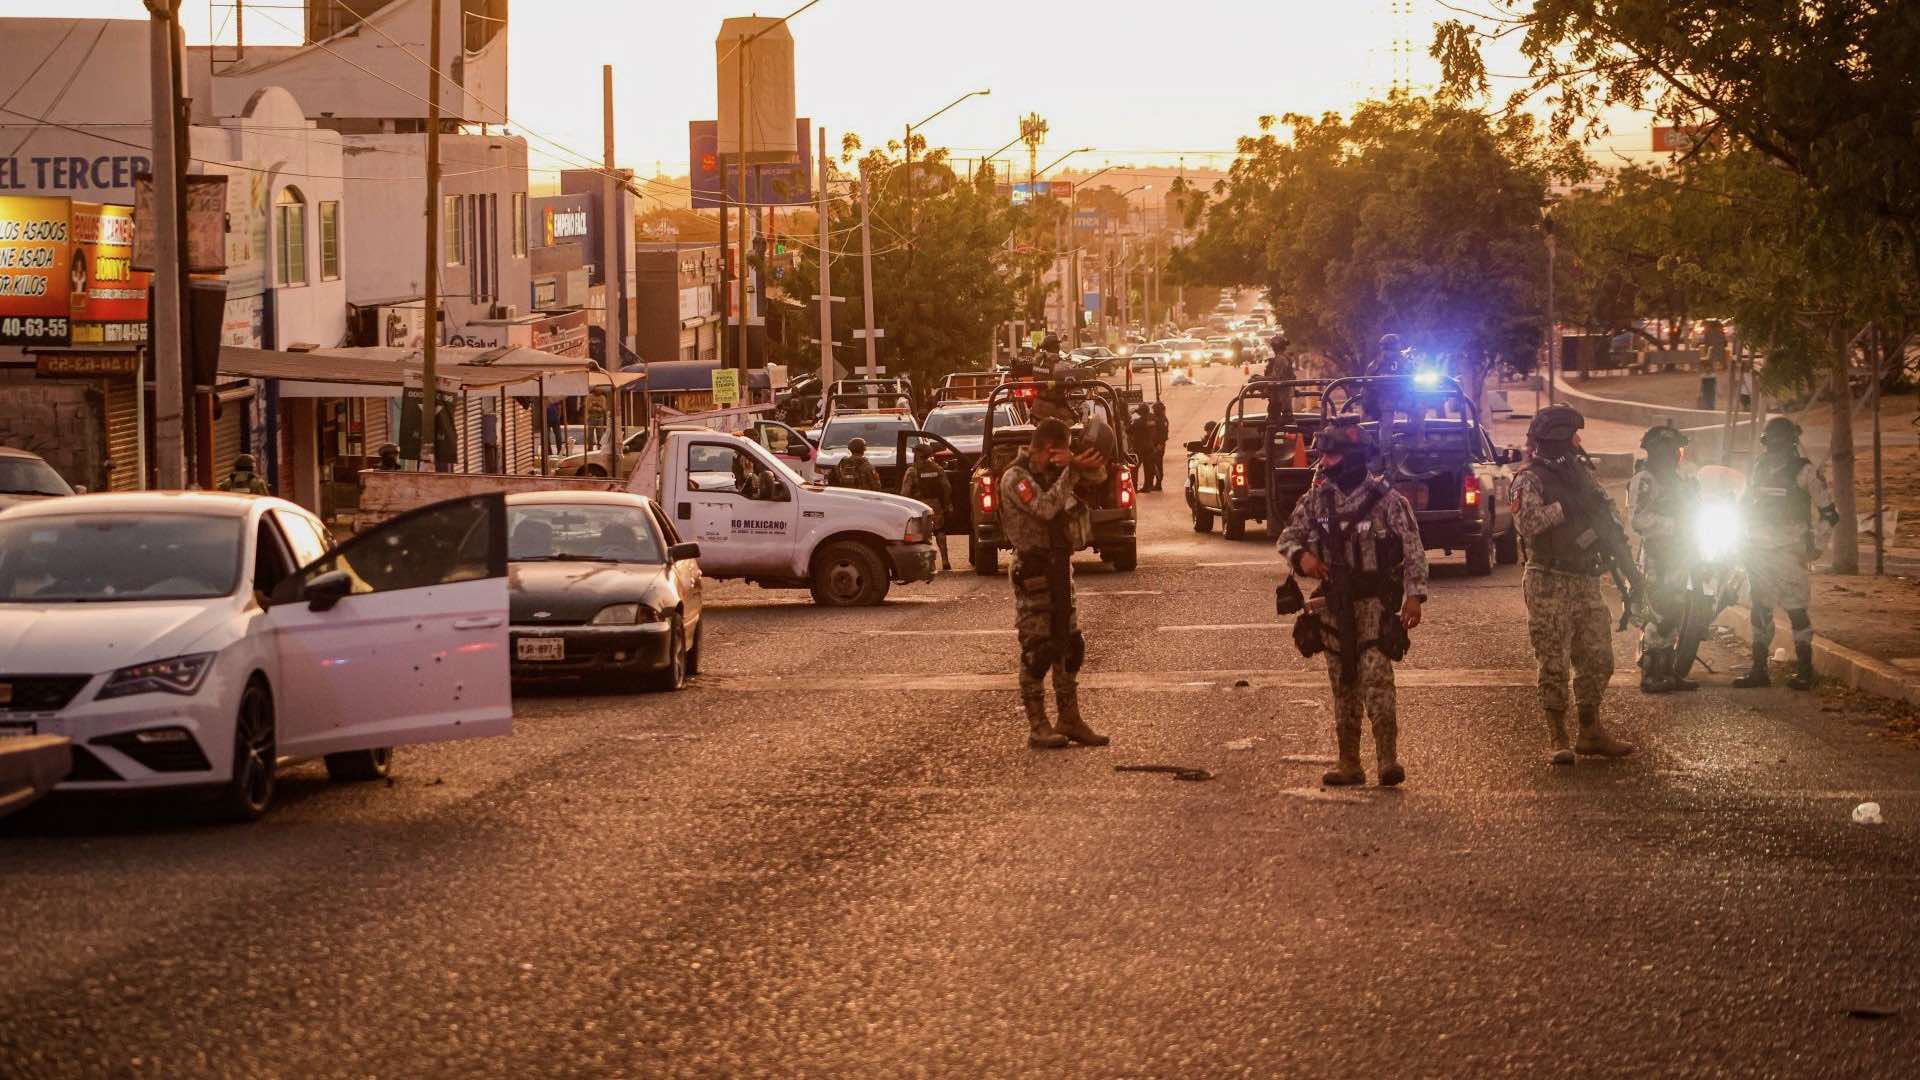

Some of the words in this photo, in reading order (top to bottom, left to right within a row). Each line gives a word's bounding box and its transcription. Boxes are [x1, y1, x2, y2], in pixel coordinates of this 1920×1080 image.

[0, 157, 26, 189] EL
[31, 157, 150, 189] TERCER
[19, 248, 53, 267] ASADA
[15, 276, 47, 295] KILOS
[3, 318, 68, 337] 40-63-55
